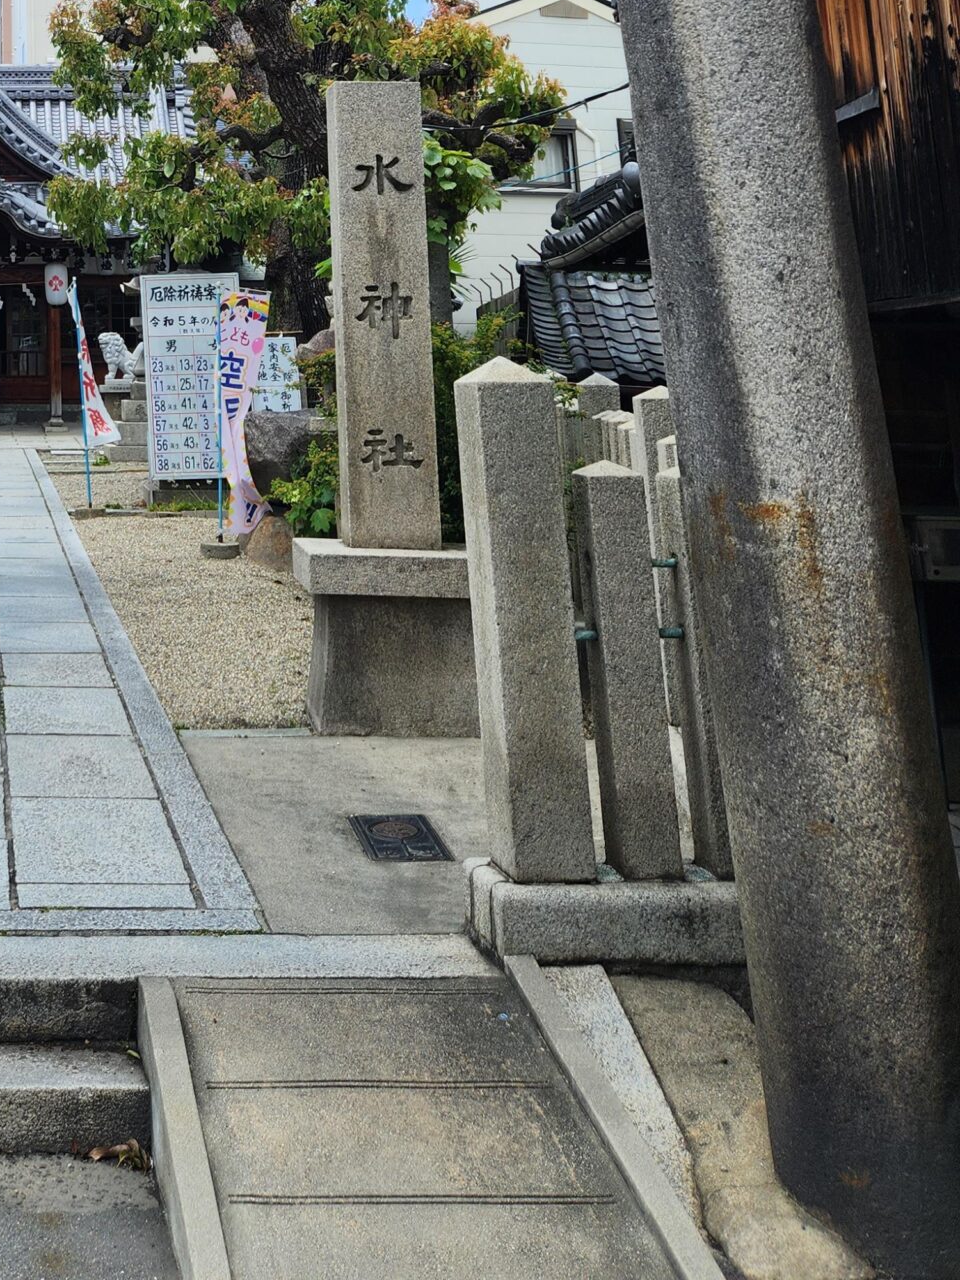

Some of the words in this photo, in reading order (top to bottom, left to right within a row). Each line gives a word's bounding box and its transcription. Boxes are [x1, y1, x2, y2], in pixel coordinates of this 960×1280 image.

[150, 283, 218, 303] 厄除祈祷案
[352, 154, 424, 473] 水神社
[166, 339, 177, 352] 男
[268, 342, 281, 382] 家内安全
